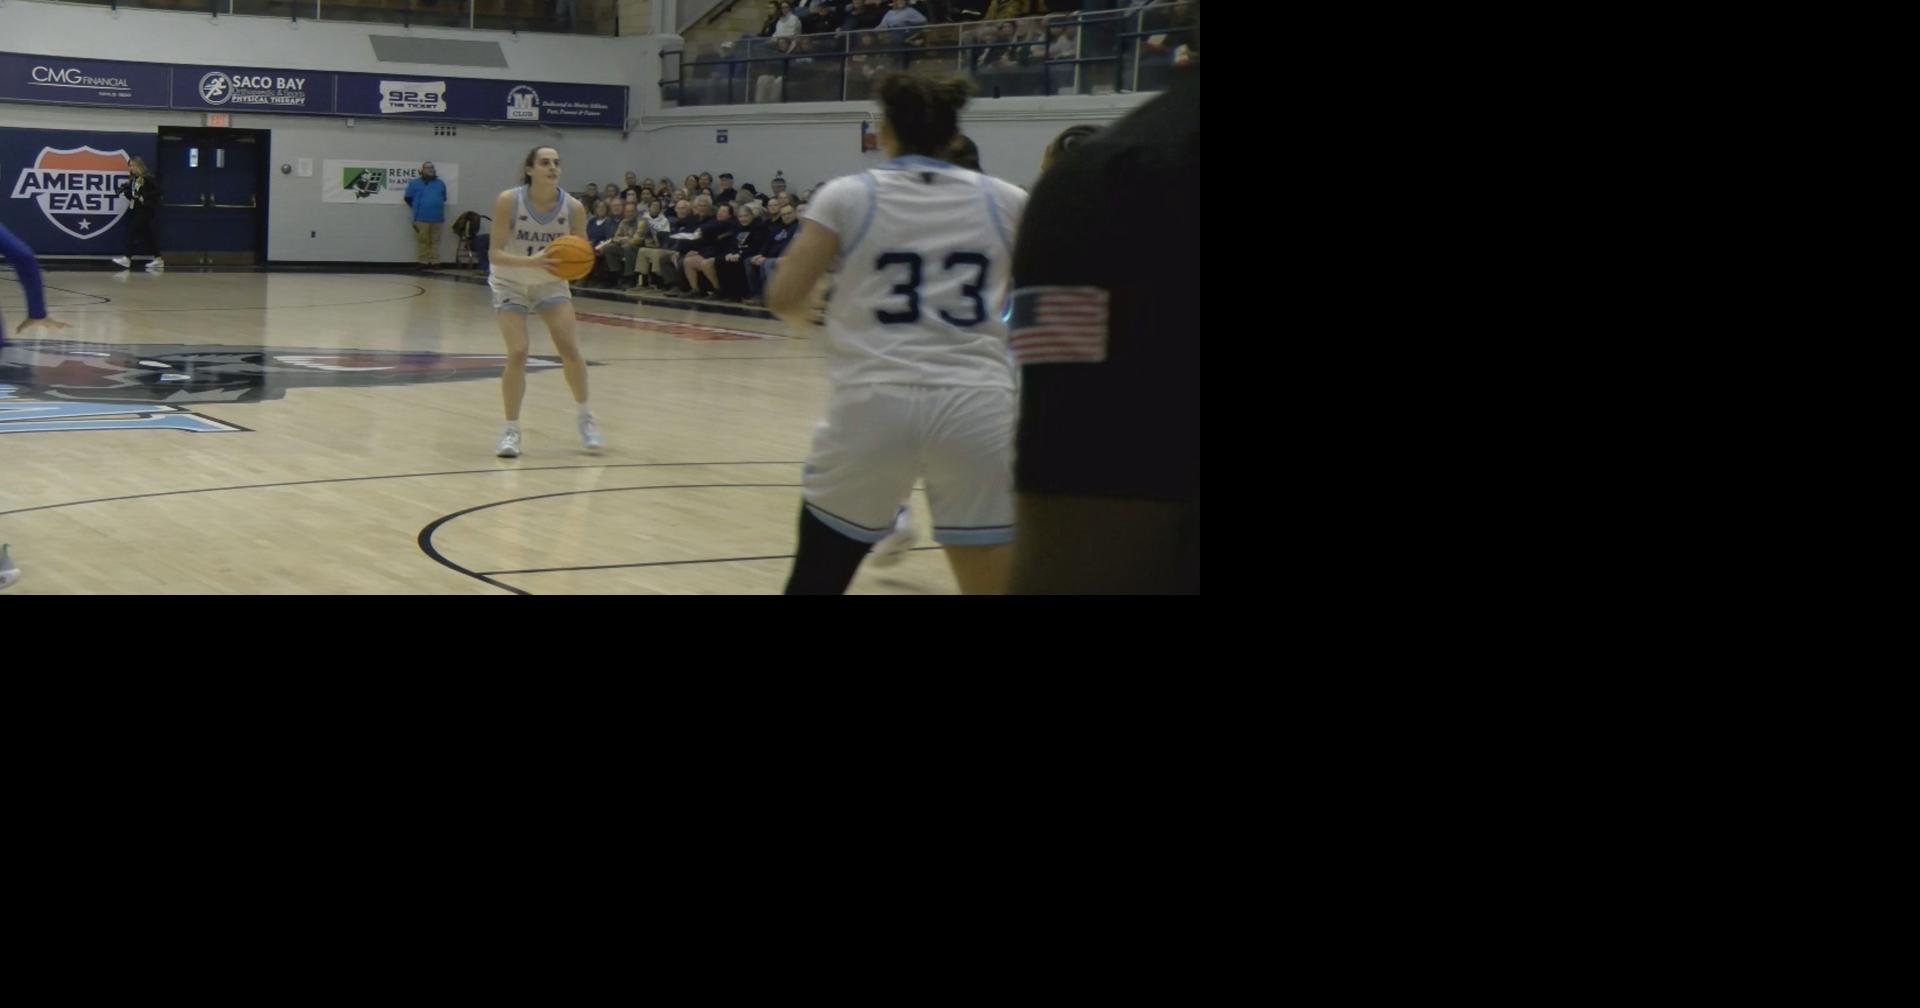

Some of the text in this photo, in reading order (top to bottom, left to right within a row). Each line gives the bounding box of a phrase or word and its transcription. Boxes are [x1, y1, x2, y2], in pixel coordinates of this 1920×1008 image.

[32, 66, 128, 87] CMG FINANCIAL
[232, 75, 305, 90] SACO BAY
[232, 95, 305, 105] PHYSICAL THERAPY
[389, 91, 438, 103] 92.9
[19, 172, 130, 195] AMERIC
[50, 193, 120, 211] EAST
[876, 252, 989, 327] 33
